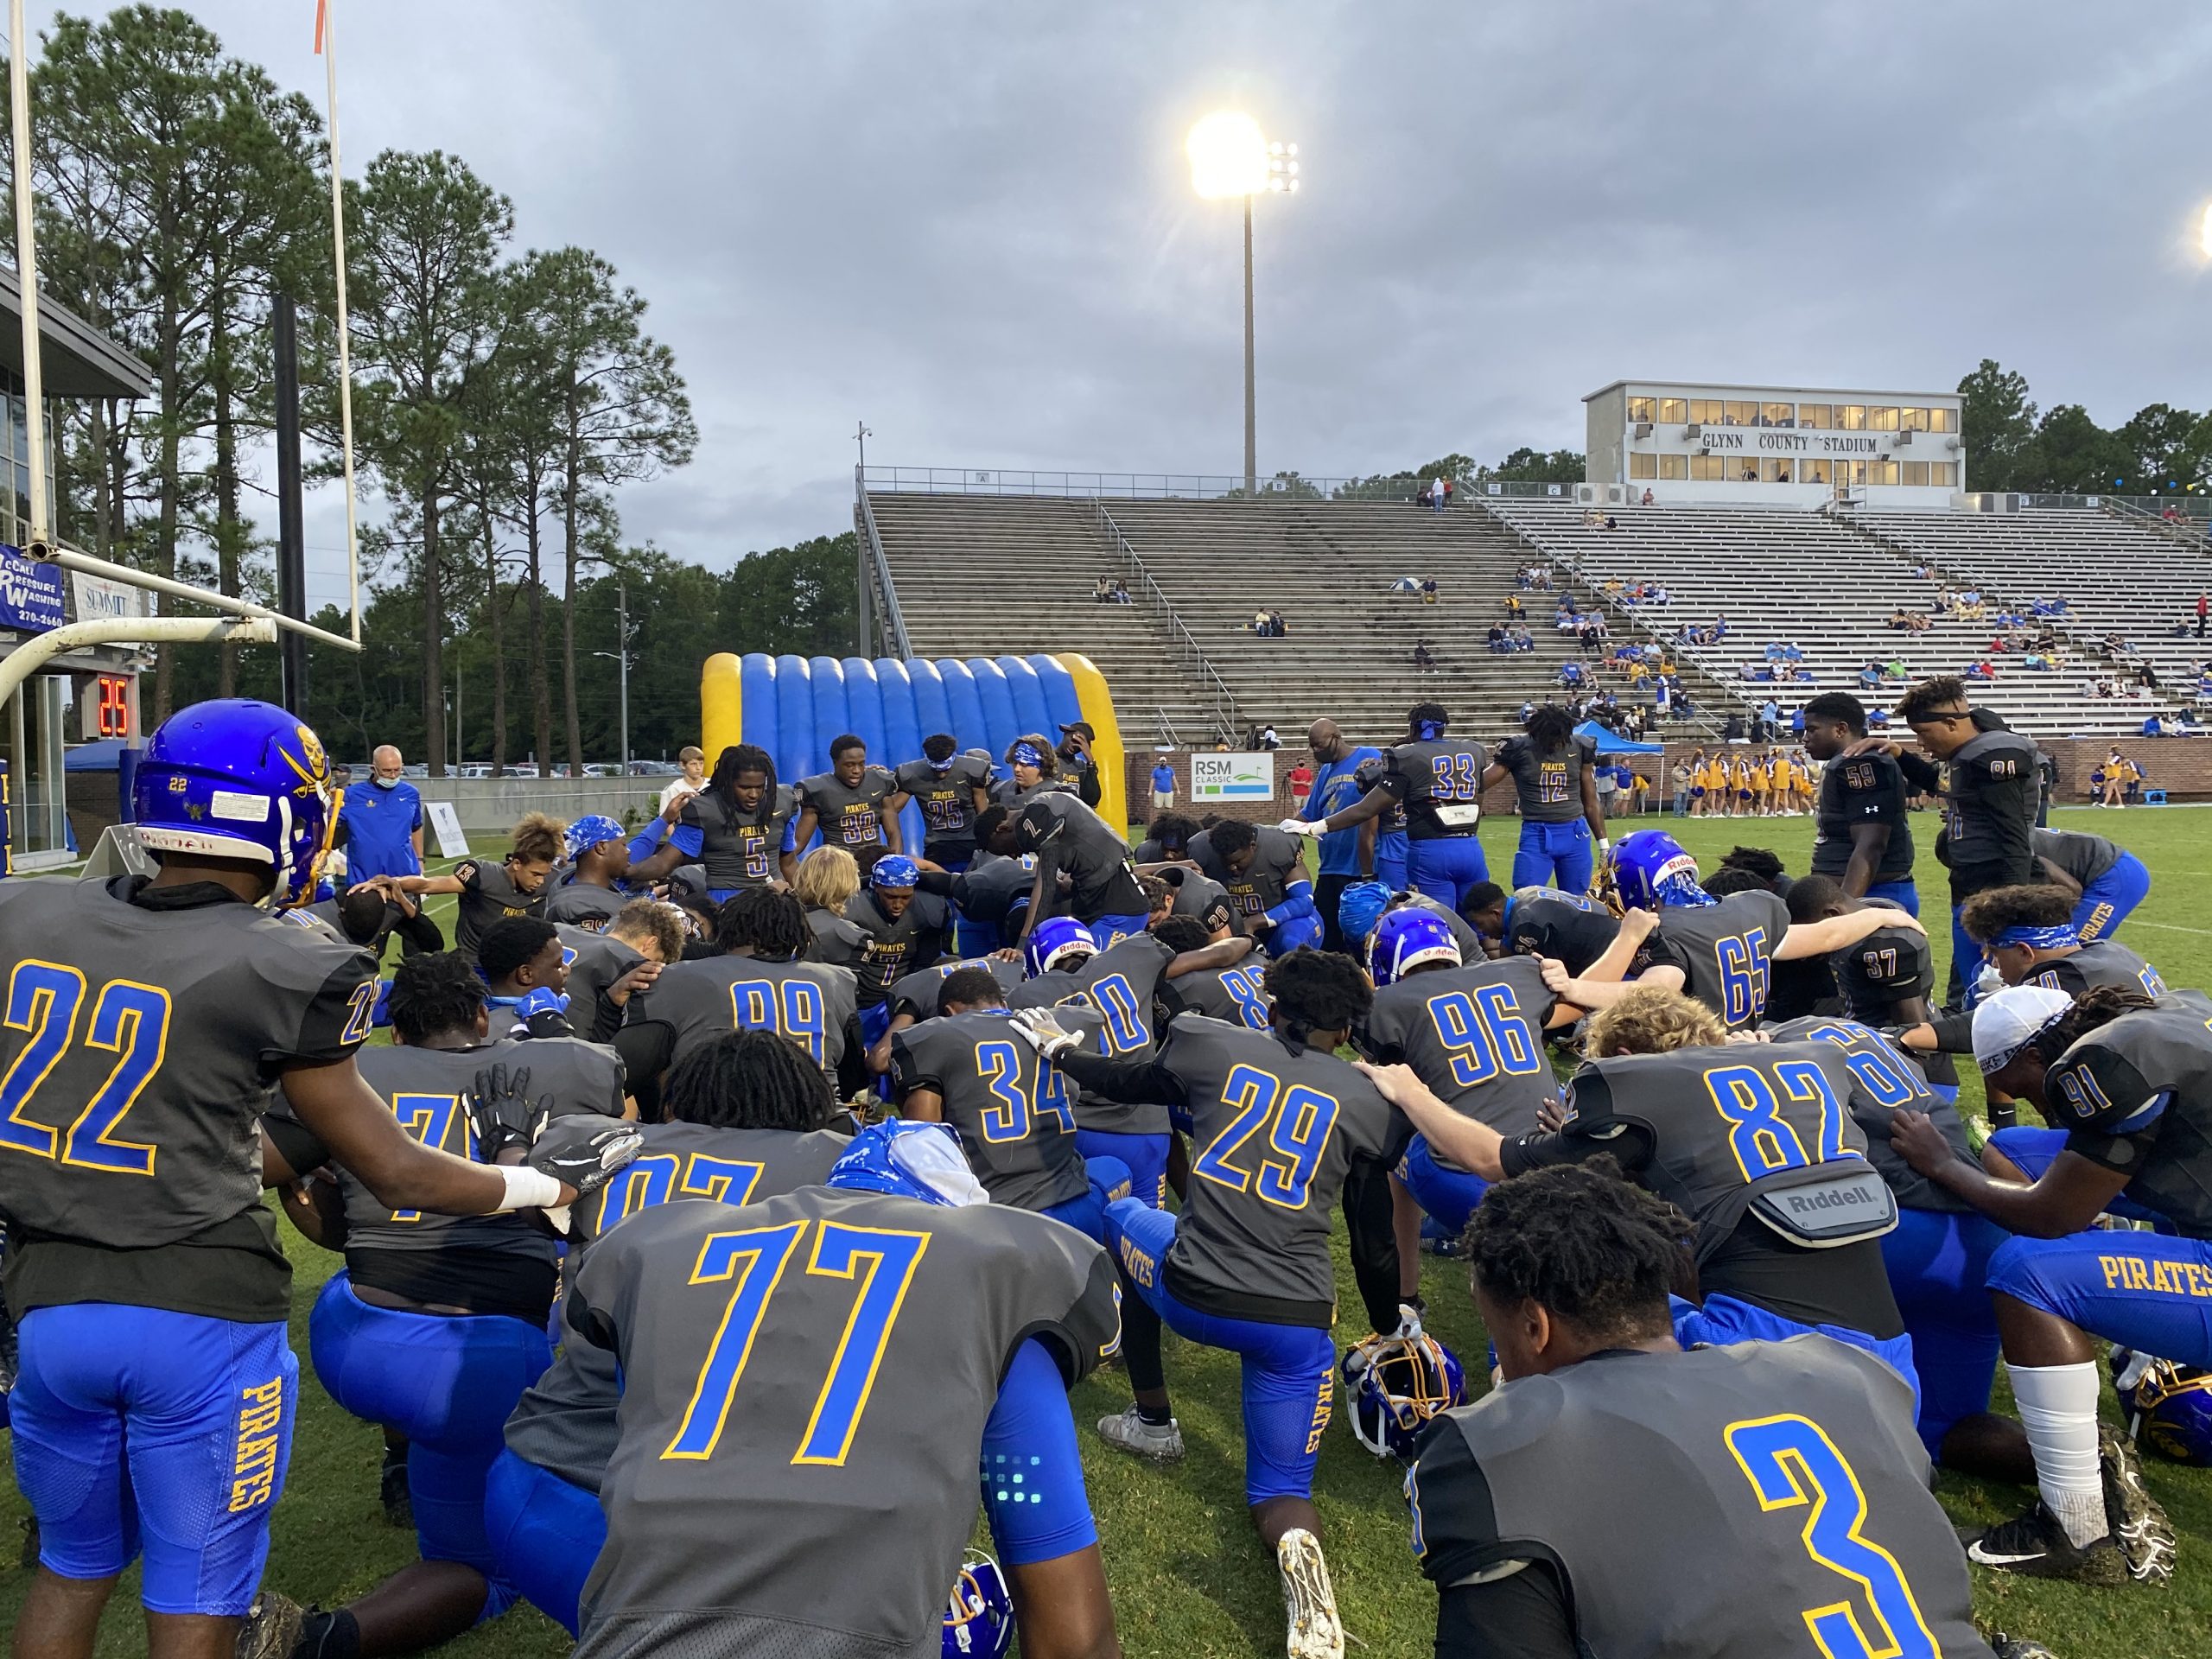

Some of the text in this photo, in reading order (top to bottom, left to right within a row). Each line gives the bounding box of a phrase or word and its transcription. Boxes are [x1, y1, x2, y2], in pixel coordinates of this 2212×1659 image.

[1703, 434, 1877, 452] GLYNN COUNTY STADIUM
[86, 588, 126, 616] SUMMIT
[168, 777, 187, 791] 22
[1195, 760, 1231, 775] RSM
[1431, 753, 1476, 800] 33
[1541, 762, 1566, 772] PIRATES
[1846, 763, 1876, 789] 59
[1990, 760, 2016, 780] 81
[931, 791, 955, 800] PIRATES
[1539, 772, 1569, 803] 12
[844, 803, 869, 814] PIRATES
[927, 798, 964, 830] 25
[739, 826, 770, 837] PIRATS
[840, 810, 877, 844] 39
[454, 864, 477, 883] 13
[745, 836, 769, 879] 5
[1228, 883, 1254, 894] PIRATES
[1207, 905, 1230, 931] 20
[2077, 902, 2114, 943] PIRATES
[875, 943, 906, 952] PIRATES
[1059, 942, 1092, 955] Riddell
[1863, 948, 1897, 979] 37
[879, 952, 902, 986] 7
[1715, 925, 1771, 1028] 65
[340, 972, 383, 1046] 22
[729, 978, 827, 1071] 99
[1427, 982, 1541, 1087] 96
[0, 959, 172, 1176] 22
[1807, 1020, 1931, 1108] 67
[975, 1039, 1077, 1143] 34
[2056, 1063, 2113, 1118] 91
[1192, 1063, 1340, 1210] 29
[1703, 1059, 1867, 1184] 82
[1787, 1185, 1873, 1214] Riddell
[1120, 1235, 1154, 1288] PIRATES
[2098, 1255, 2212, 1298] PIRATES
[659, 1219, 932, 1466] 77
[1305, 1364, 1335, 1455] PIRATES
[226, 1376, 282, 1513] PIRATES
[1723, 1412, 1942, 1659] 3
